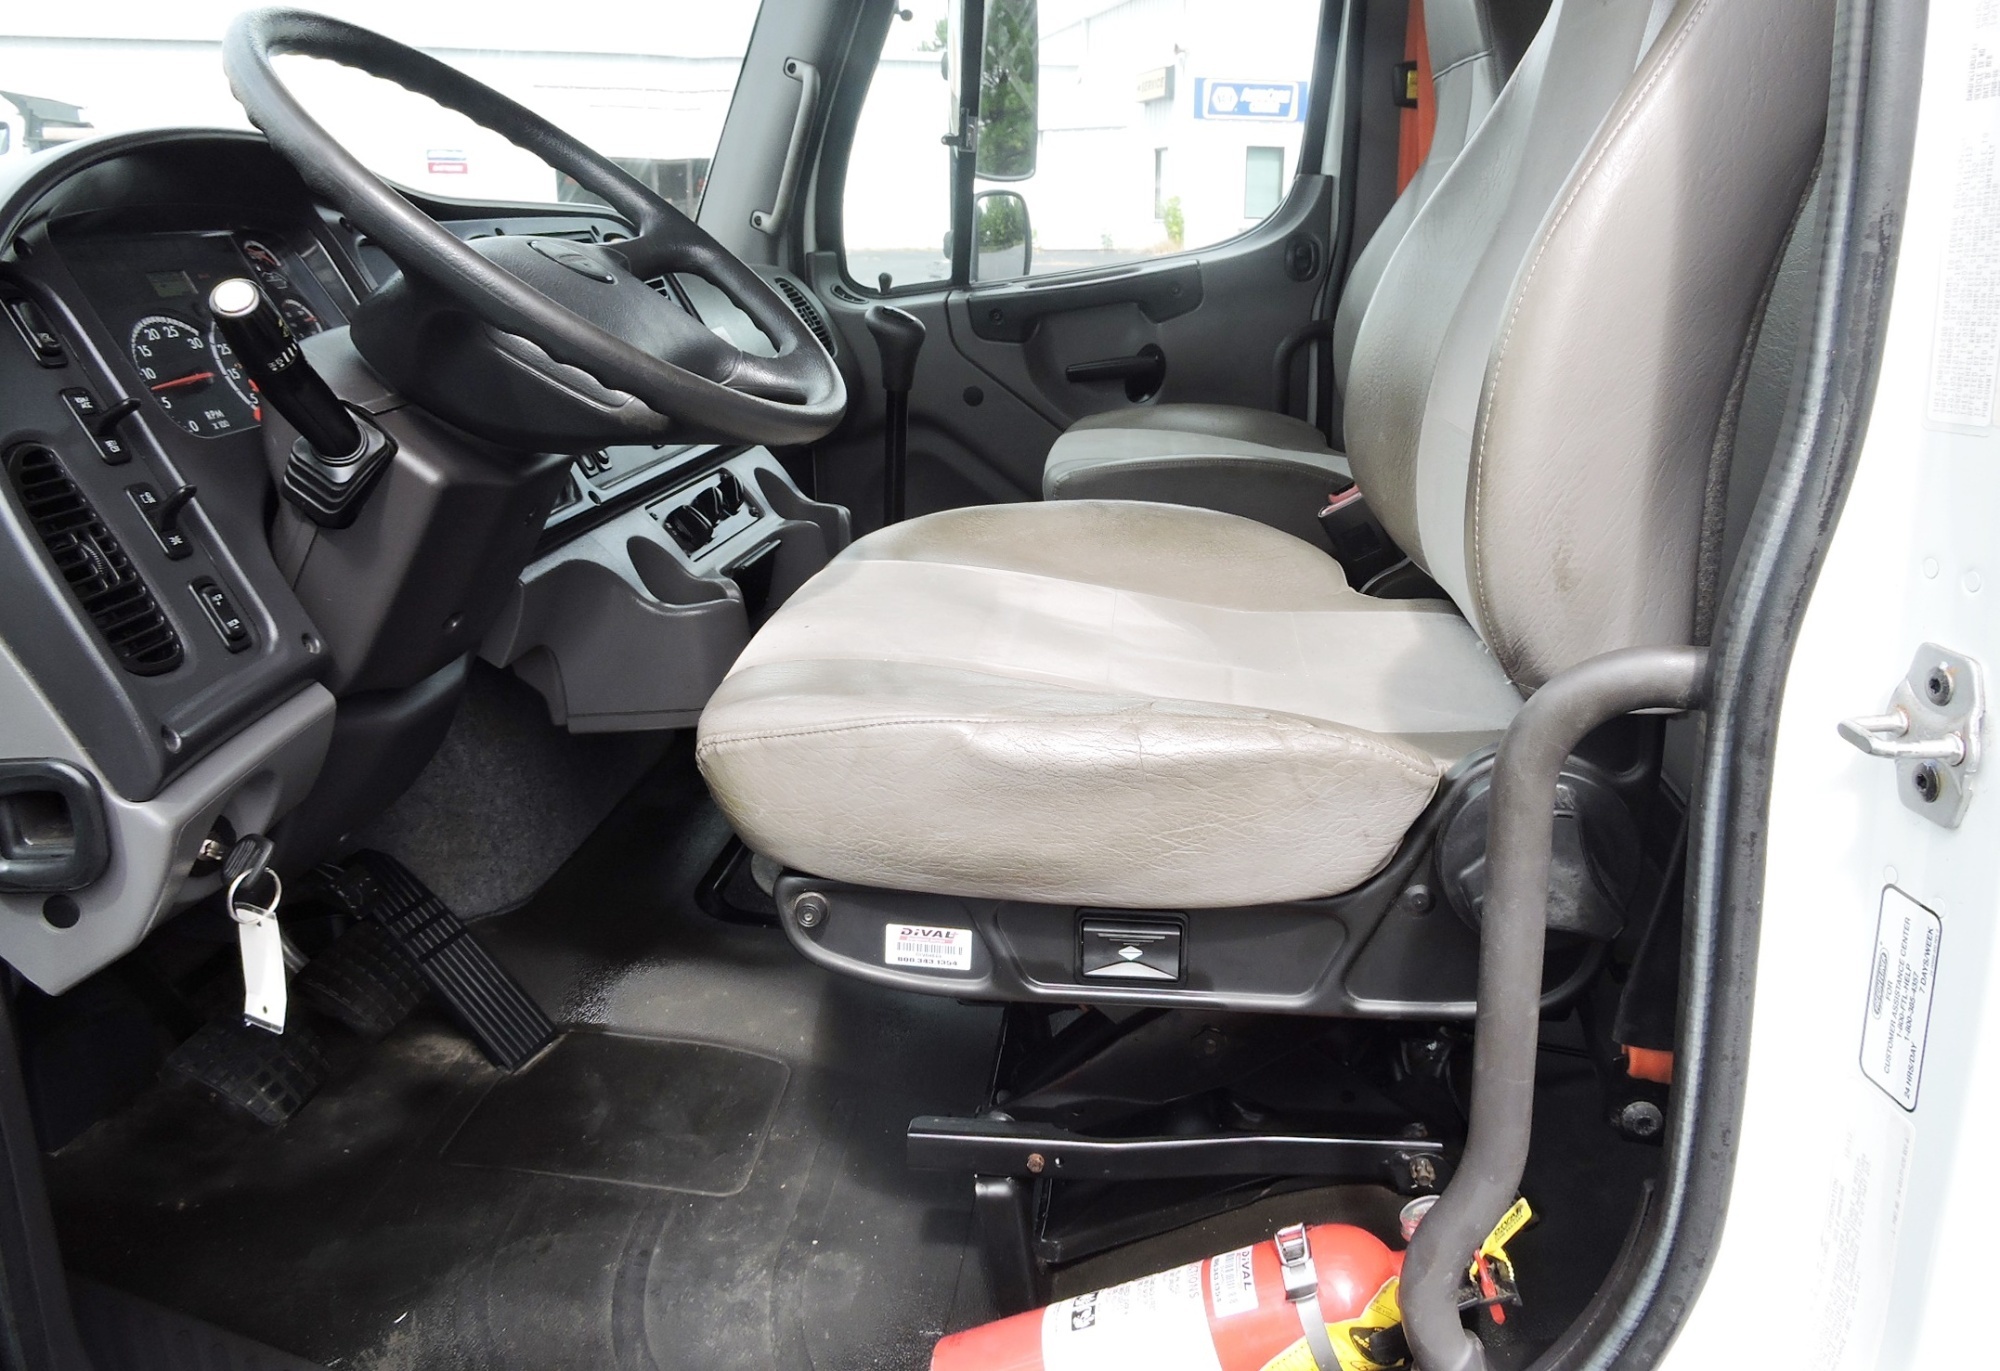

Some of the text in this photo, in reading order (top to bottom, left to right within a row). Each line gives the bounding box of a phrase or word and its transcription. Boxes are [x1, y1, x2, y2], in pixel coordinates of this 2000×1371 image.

[144, 328, 160, 341] 20
[163, 326, 179, 338] 25
[187, 337, 204, 349] 30
[217, 343, 232, 355] 25
[137, 345, 153, 357] 15
[141, 367, 157, 380] 10
[227, 368, 241, 380] 15
[161, 396, 172, 409] 5
[249, 393, 259, 405] 5
[204, 409, 225, 420] RPM
[188, 420, 200, 432] 0
[1920, 927, 1934, 986] DAYS/WEEK
[1884, 917, 1911, 1074] CUSTOMER ASSISTANCE CENTER
[1885, 980, 1893, 1002] FOR
[1896, 963, 1911, 1038] 1-800-FTL-HELP
[1904, 971, 1919, 1041] 1-800-385-4357
[1904, 1042, 1918, 1099] 24 HRS/DAY
